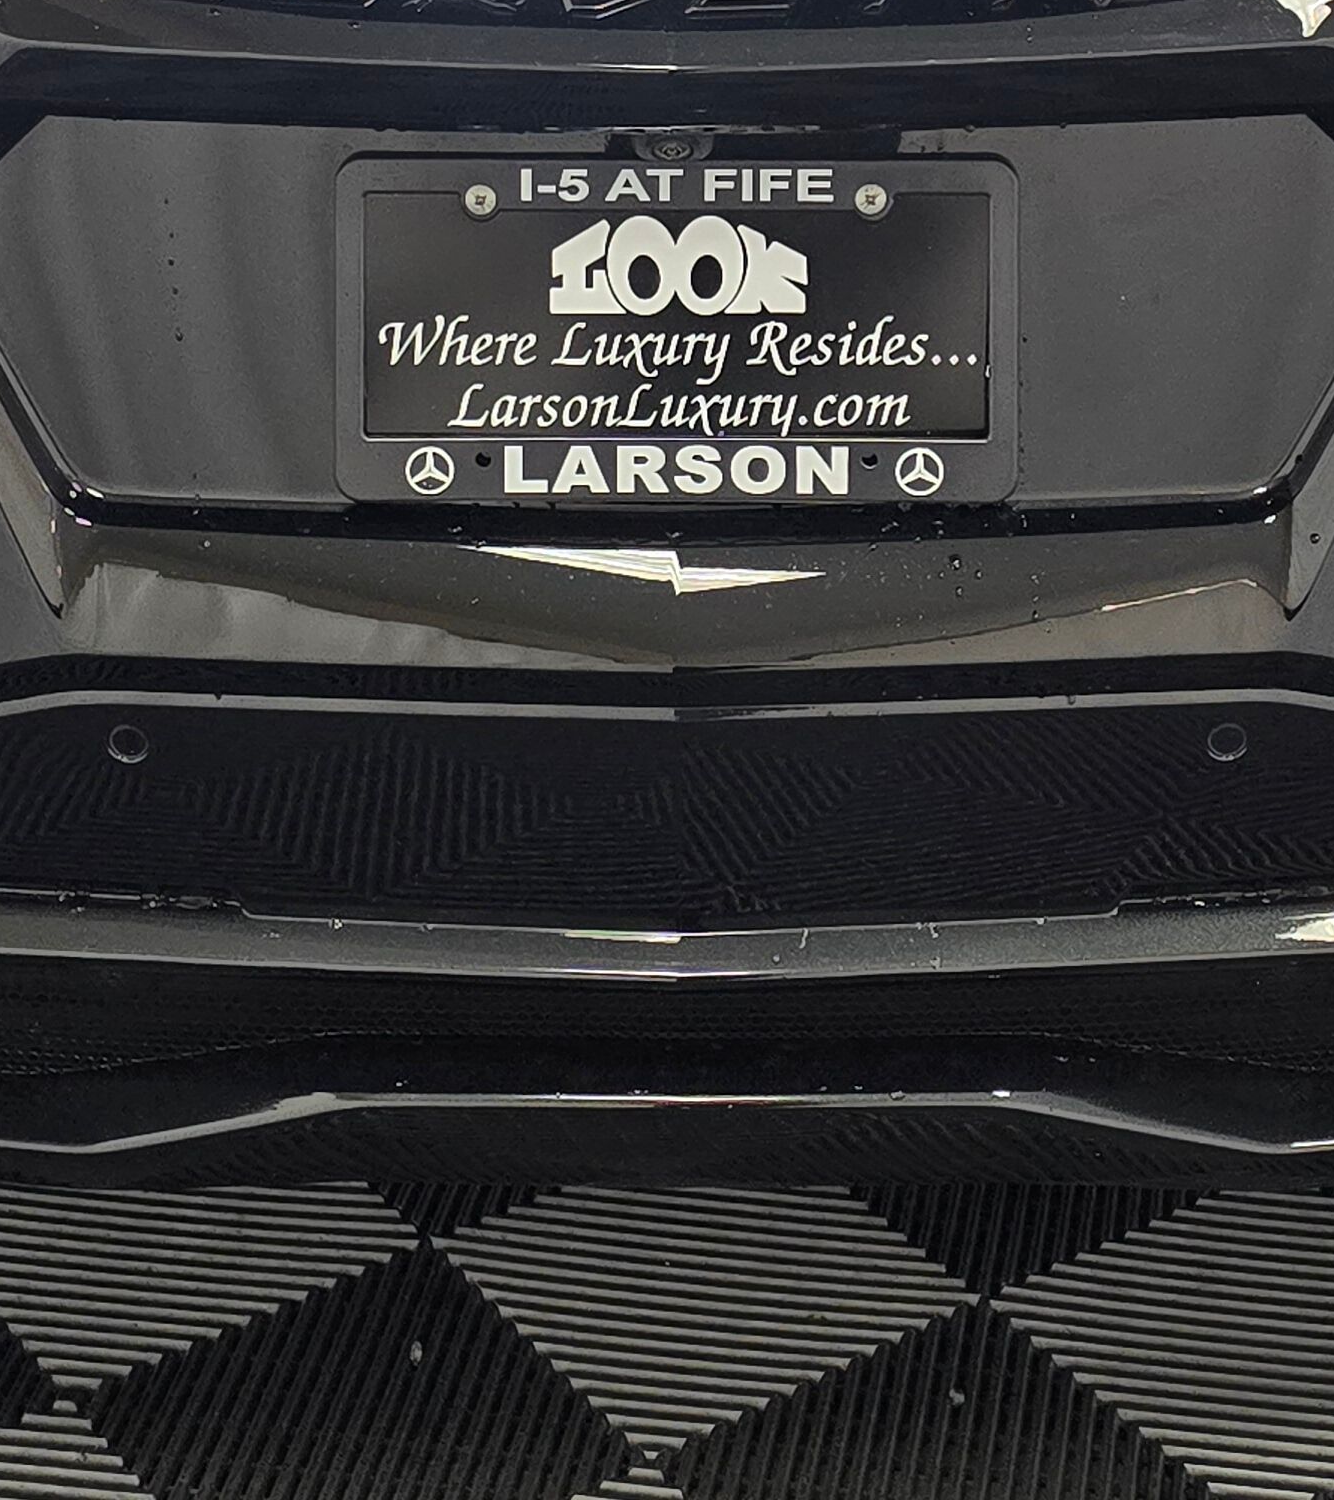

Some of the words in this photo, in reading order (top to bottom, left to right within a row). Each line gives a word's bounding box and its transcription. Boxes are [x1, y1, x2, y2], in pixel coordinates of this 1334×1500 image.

[520, 168, 590, 202] I-5
[605, 168, 684, 202] AT
[703, 168, 834, 203] FIFE
[549, 215, 809, 316] LOOK
[378, 314, 537, 366] Where
[550, 322, 731, 385] Luxury
[745, 315, 977, 376] Resides...
[446, 383, 911, 438] LarsonLuxury.com
[503, 444, 850, 495] LARSON
